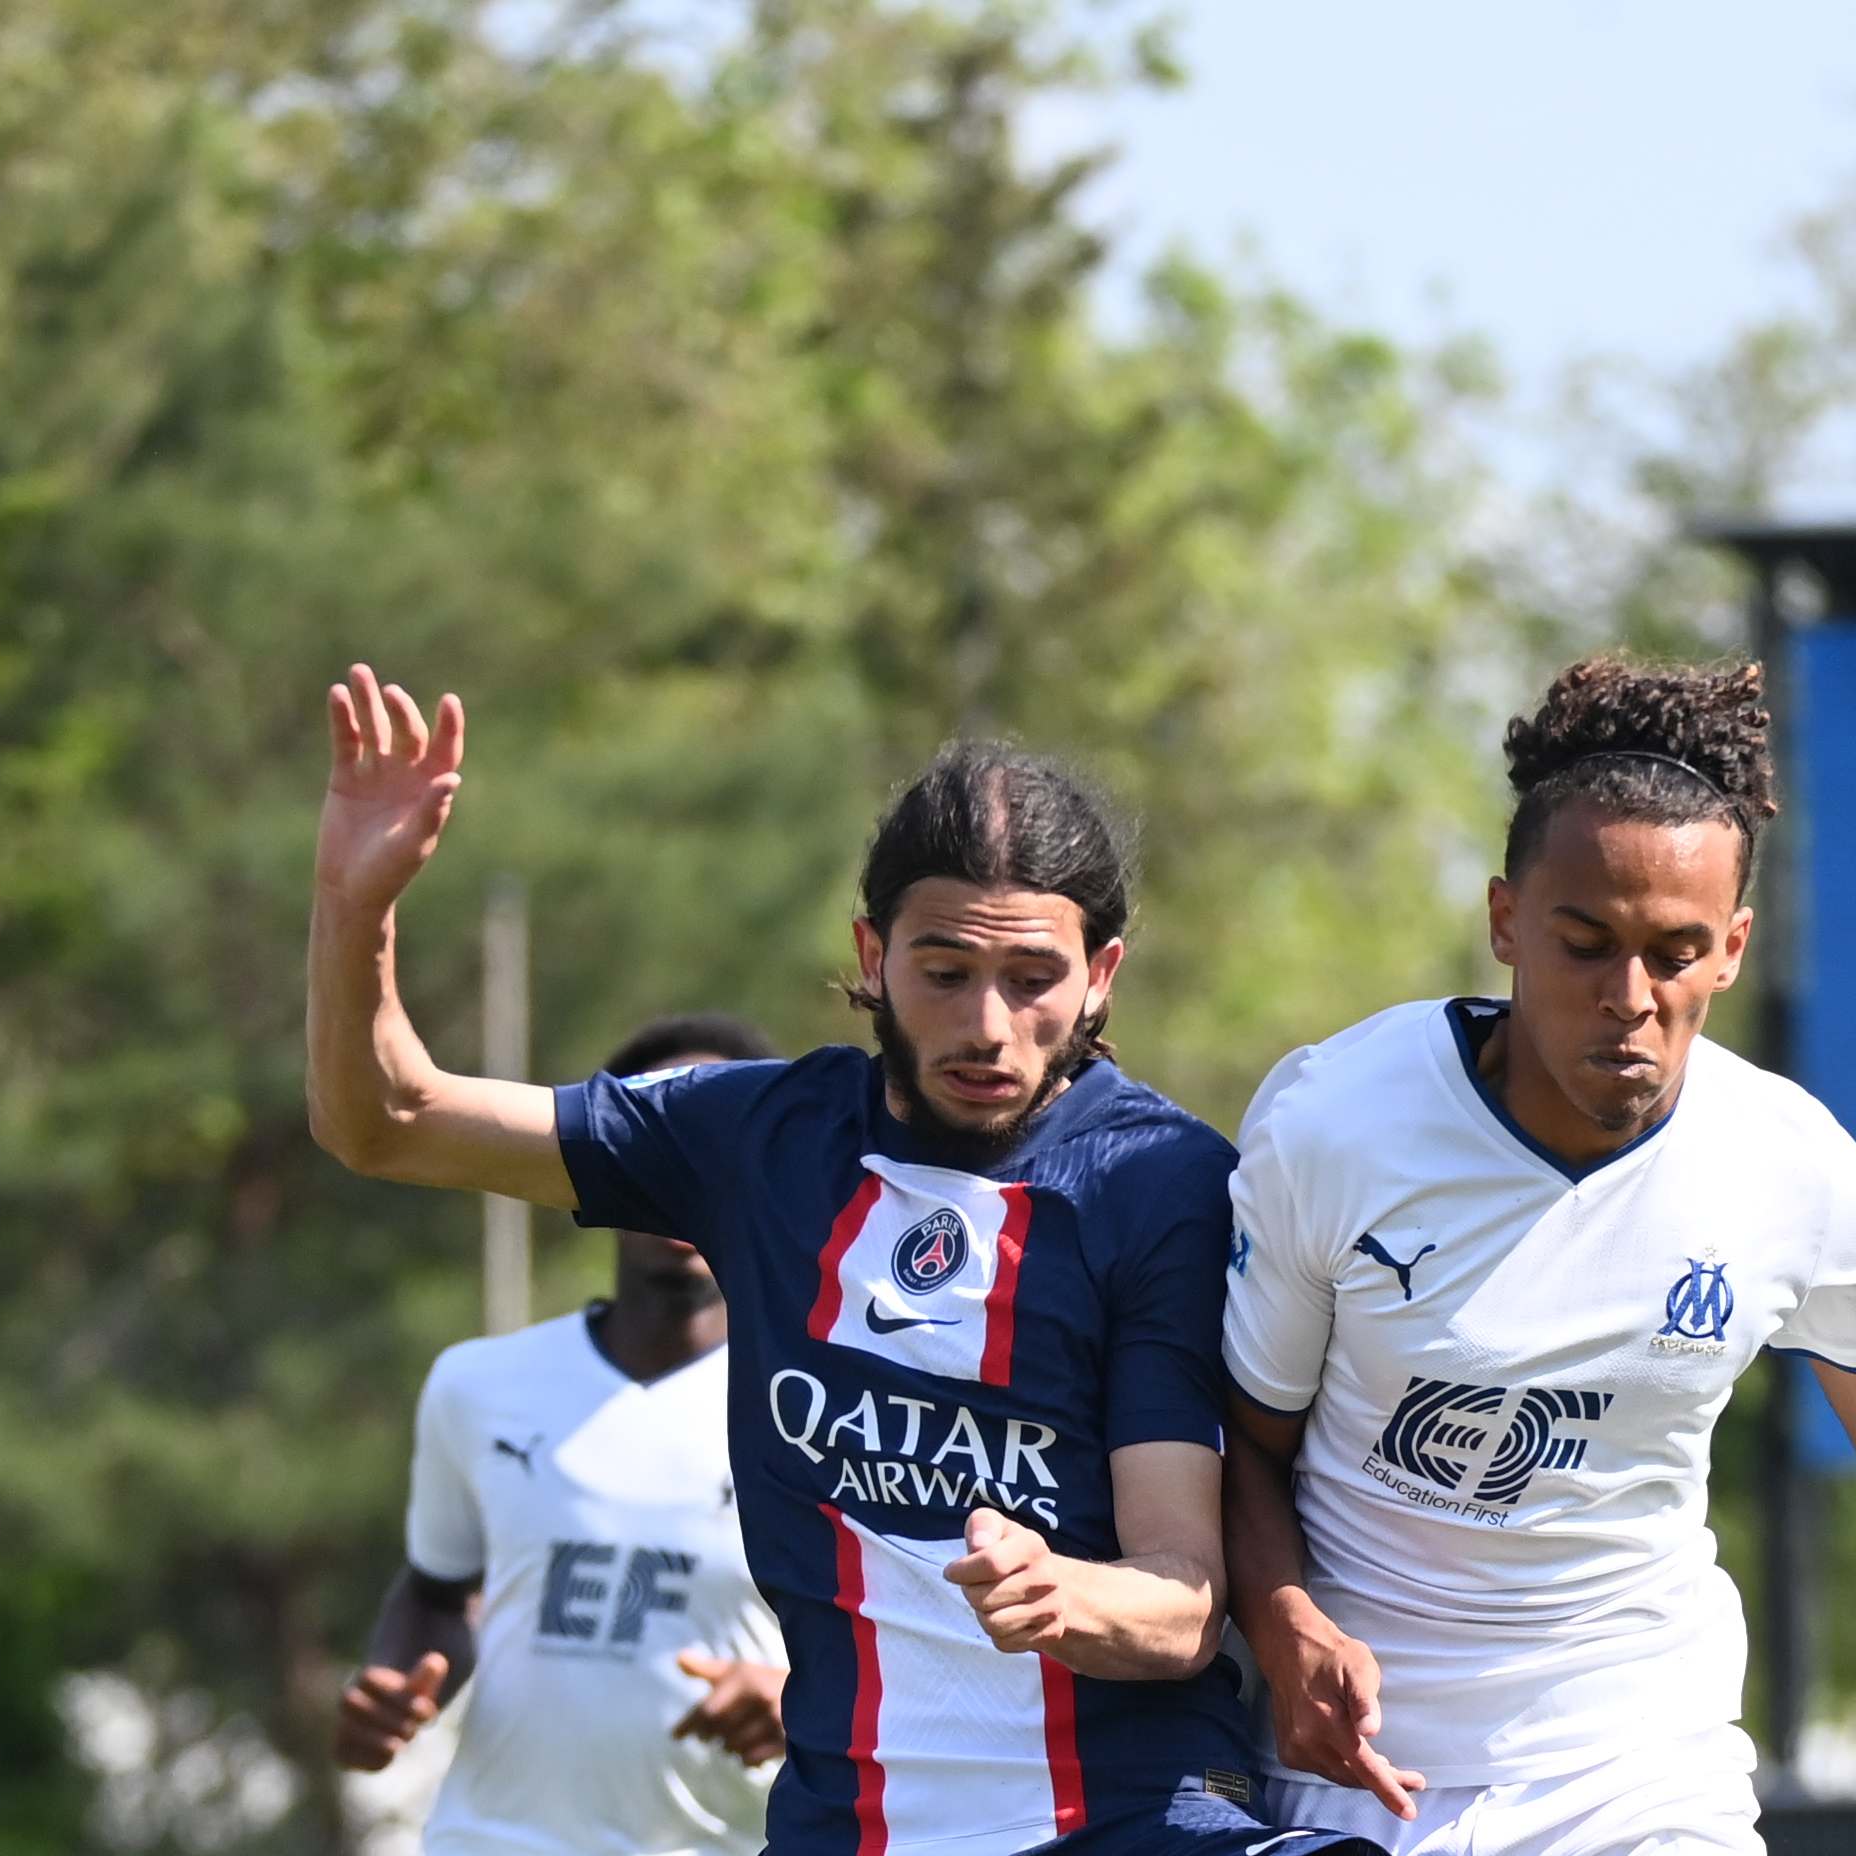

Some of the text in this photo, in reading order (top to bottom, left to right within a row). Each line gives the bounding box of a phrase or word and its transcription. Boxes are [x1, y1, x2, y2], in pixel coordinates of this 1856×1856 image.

[921, 1215, 960, 1237] PARIS
[769, 1369, 1060, 1489] QATAR
[830, 1457, 1060, 1531] AIRWAYS
[1361, 1455, 1510, 1528] Education First
[539, 1540, 701, 1643] EF
